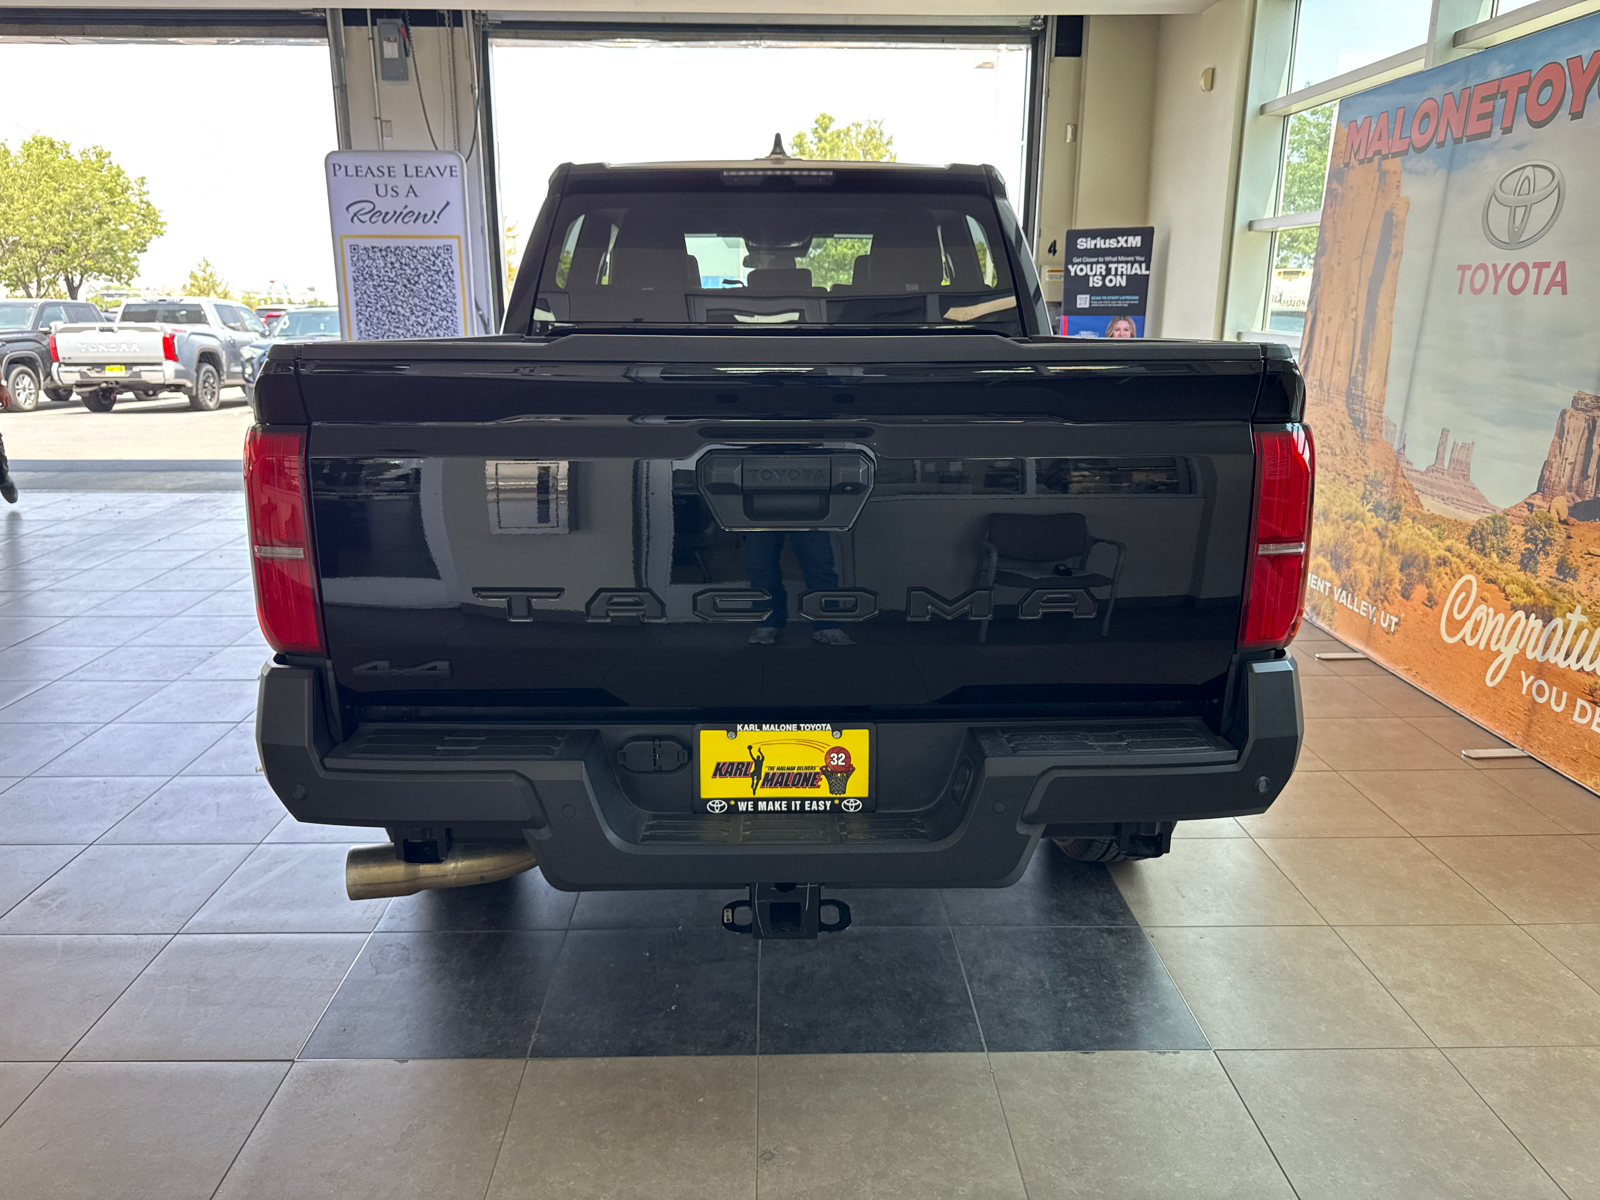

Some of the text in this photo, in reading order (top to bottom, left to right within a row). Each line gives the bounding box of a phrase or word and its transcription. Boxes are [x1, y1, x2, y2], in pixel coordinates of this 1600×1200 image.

[1343, 49, 1600, 168] MALONETOY
[332, 163, 458, 179] PLEASE LEAVE
[405, 185, 420, 198] A
[345, 200, 450, 225] Review!
[1047, 239, 1058, 257] 4
[1076, 235, 1142, 250] SiriusXM
[1067, 263, 1150, 276] YOUR TRIAL
[1088, 275, 1126, 287] IS ON
[1456, 261, 1568, 296] TOYOTA
[77, 342, 141, 352] TUNDRA
[747, 469, 826, 484] TOYOTA
[471, 586, 1099, 622] TACOMA
[1333, 585, 1377, 626] VALLEY,
[1380, 610, 1399, 633] UT
[1440, 574, 1600, 687] Congratu
[1520, 670, 1568, 713] YOU
[736, 723, 832, 732] KARL MALONE TOYOTA
[829, 752, 846, 766] 32
[712, 761, 822, 789] KARL MALONE
[738, 800, 832, 811] WE MAKE IT EASY
